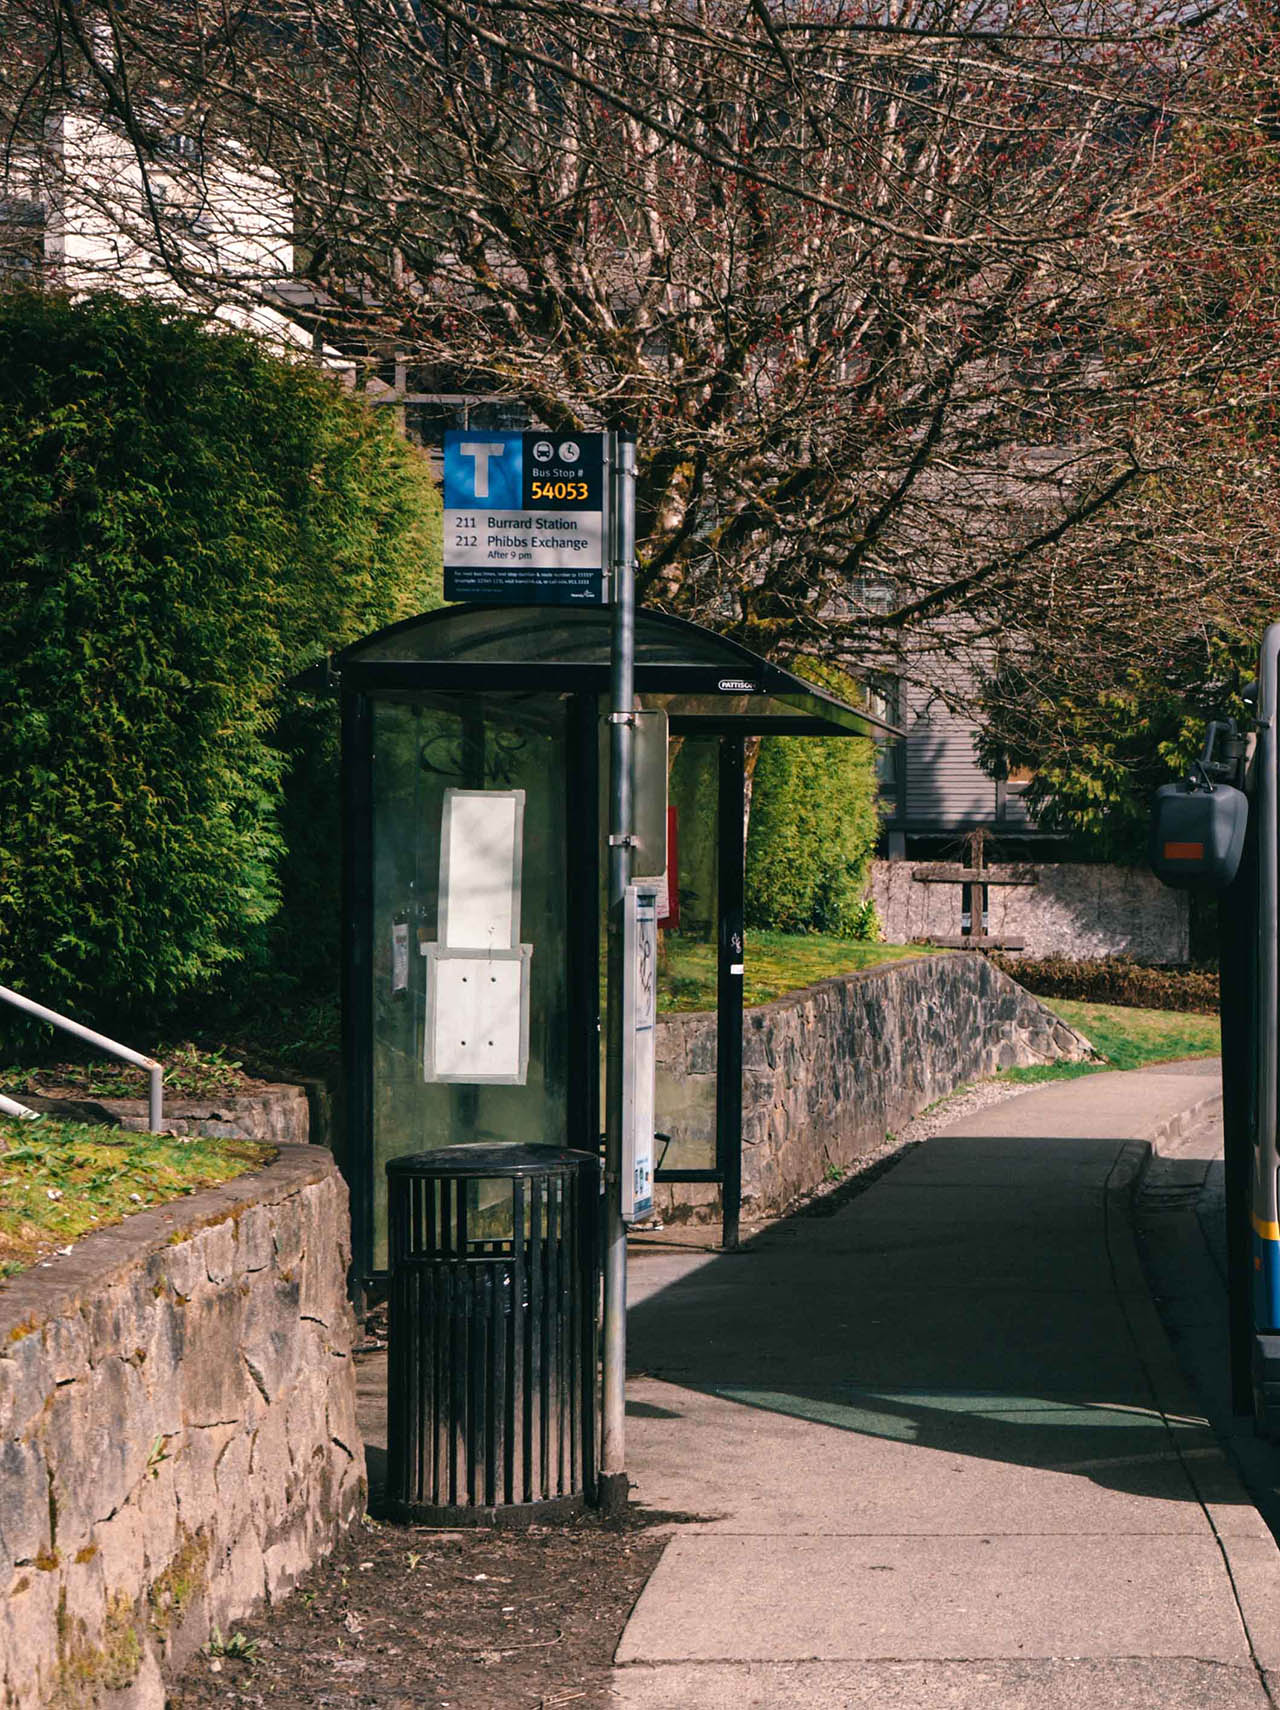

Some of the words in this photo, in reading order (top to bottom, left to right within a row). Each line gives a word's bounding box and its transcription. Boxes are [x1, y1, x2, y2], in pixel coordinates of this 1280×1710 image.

[460, 442, 505, 498] T
[532, 467, 550, 478] Bus
[553, 467, 576, 479] Stop
[531, 481, 589, 500] 54053
[455, 517, 476, 528] 211
[487, 516, 532, 530] Burrard
[535, 517, 578, 531] Station
[455, 535, 477, 547] 212
[487, 535, 528, 548] Phibbs
[531, 536, 589, 551] Exchange
[487, 550, 508, 560] After
[510, 551, 516, 560] 9
[518, 552, 532, 561] pm
